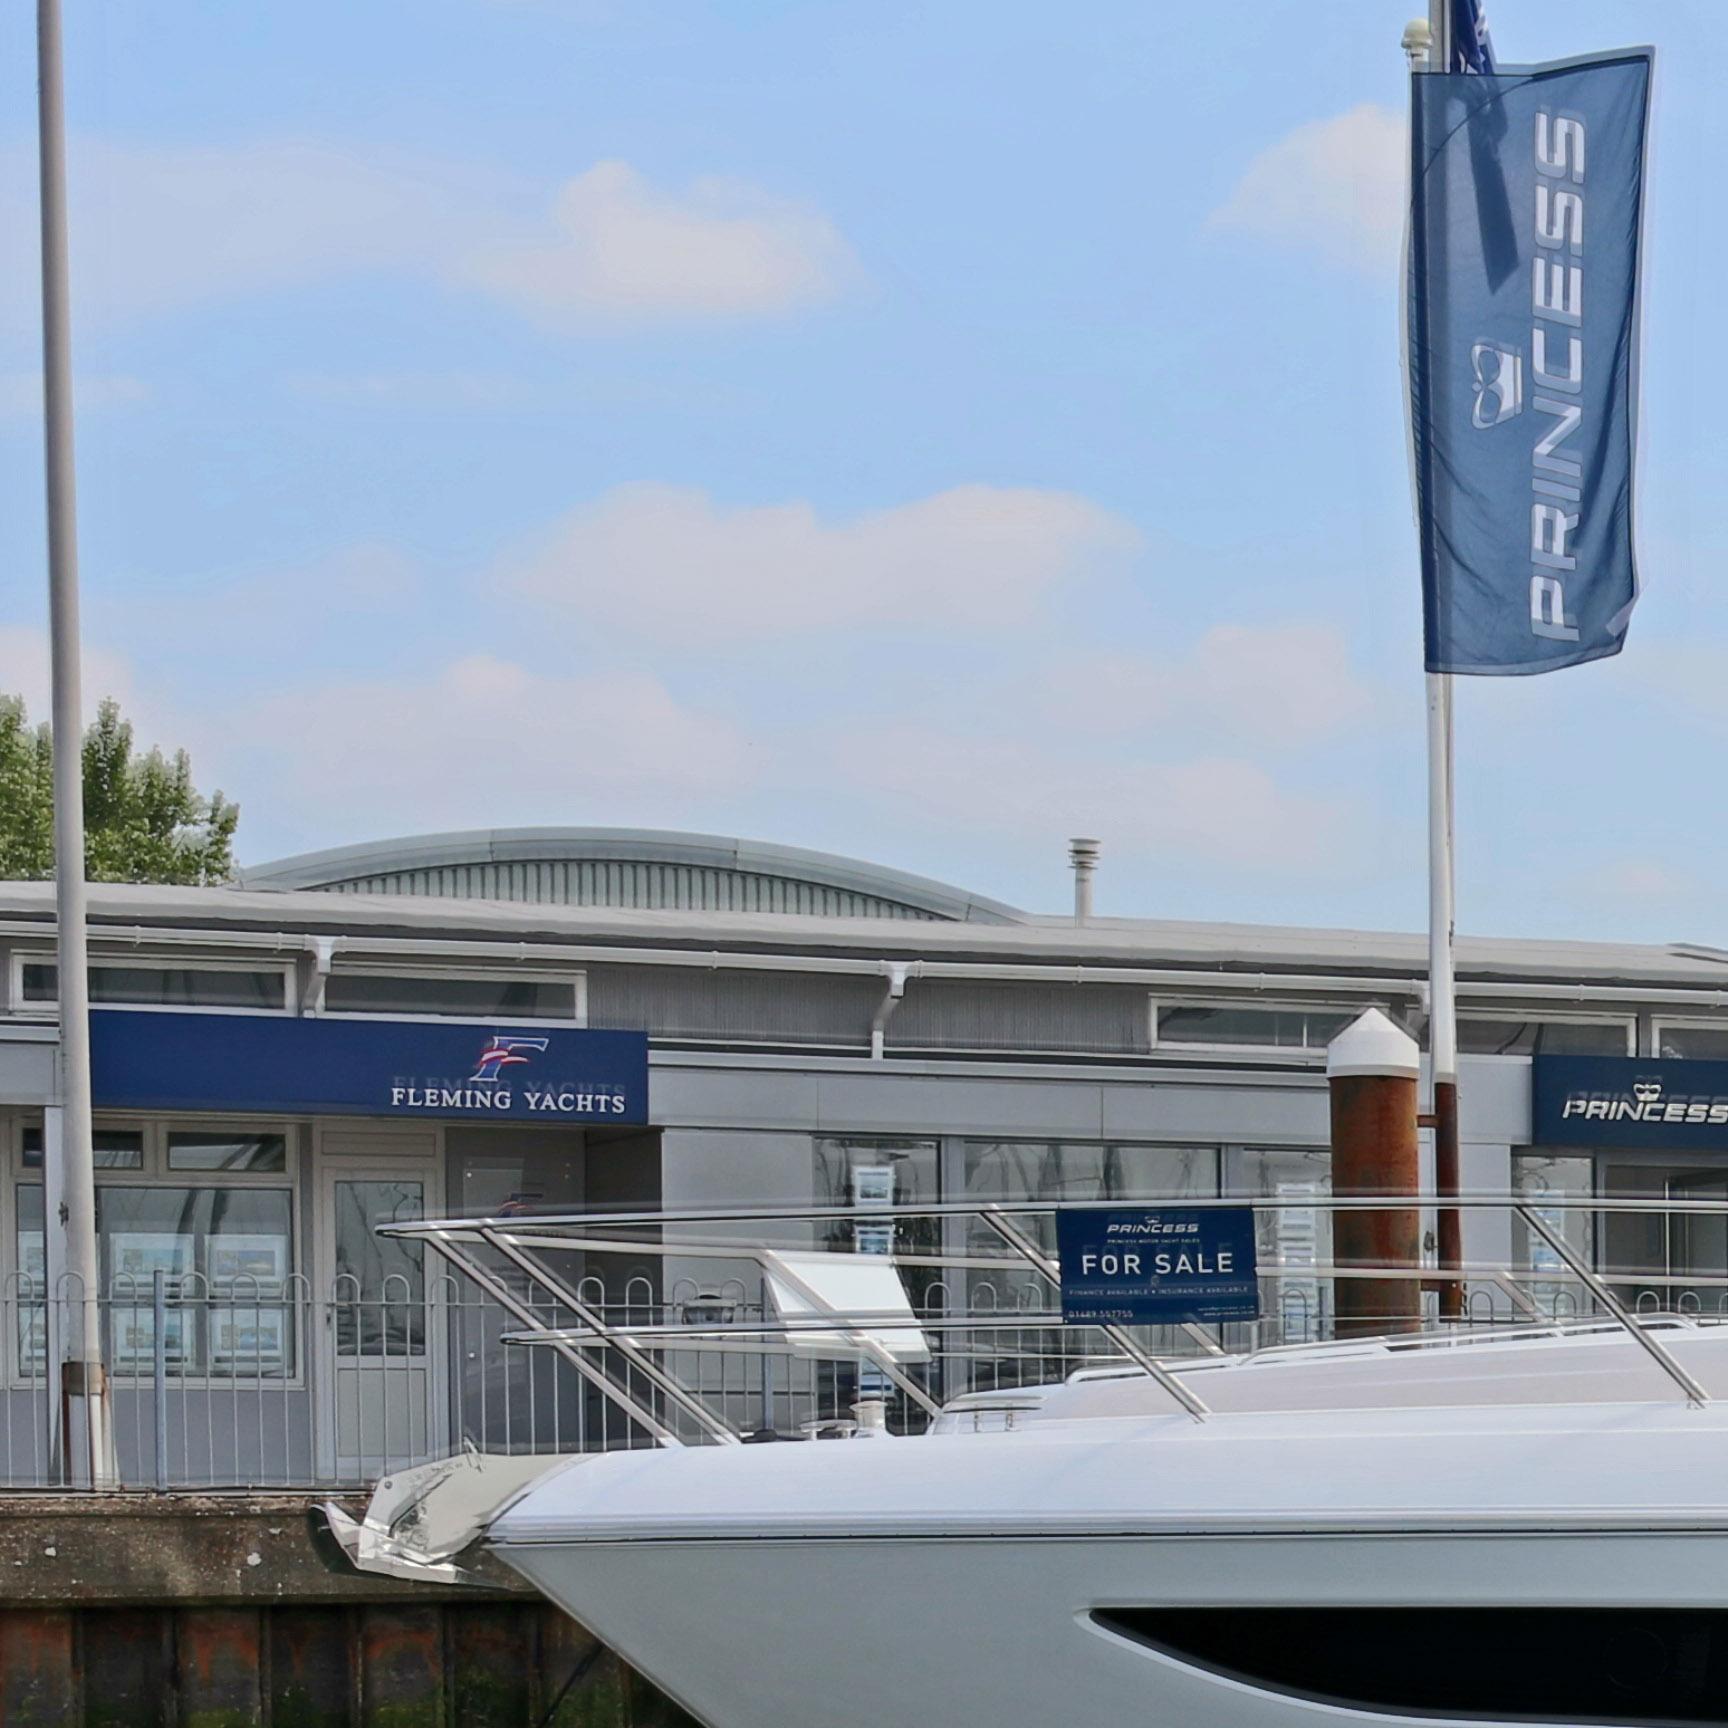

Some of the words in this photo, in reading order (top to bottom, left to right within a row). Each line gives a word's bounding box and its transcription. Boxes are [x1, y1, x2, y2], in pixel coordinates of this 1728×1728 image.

[1530, 108, 1587, 642] PRINCESS
[391, 1087, 511, 1110] FLEMING
[524, 1092, 625, 1114] YACHTS
[1106, 1223, 1199, 1233] PRINCESS
[1082, 1254, 1141, 1275] FOR
[1155, 1253, 1233, 1274] SALE
